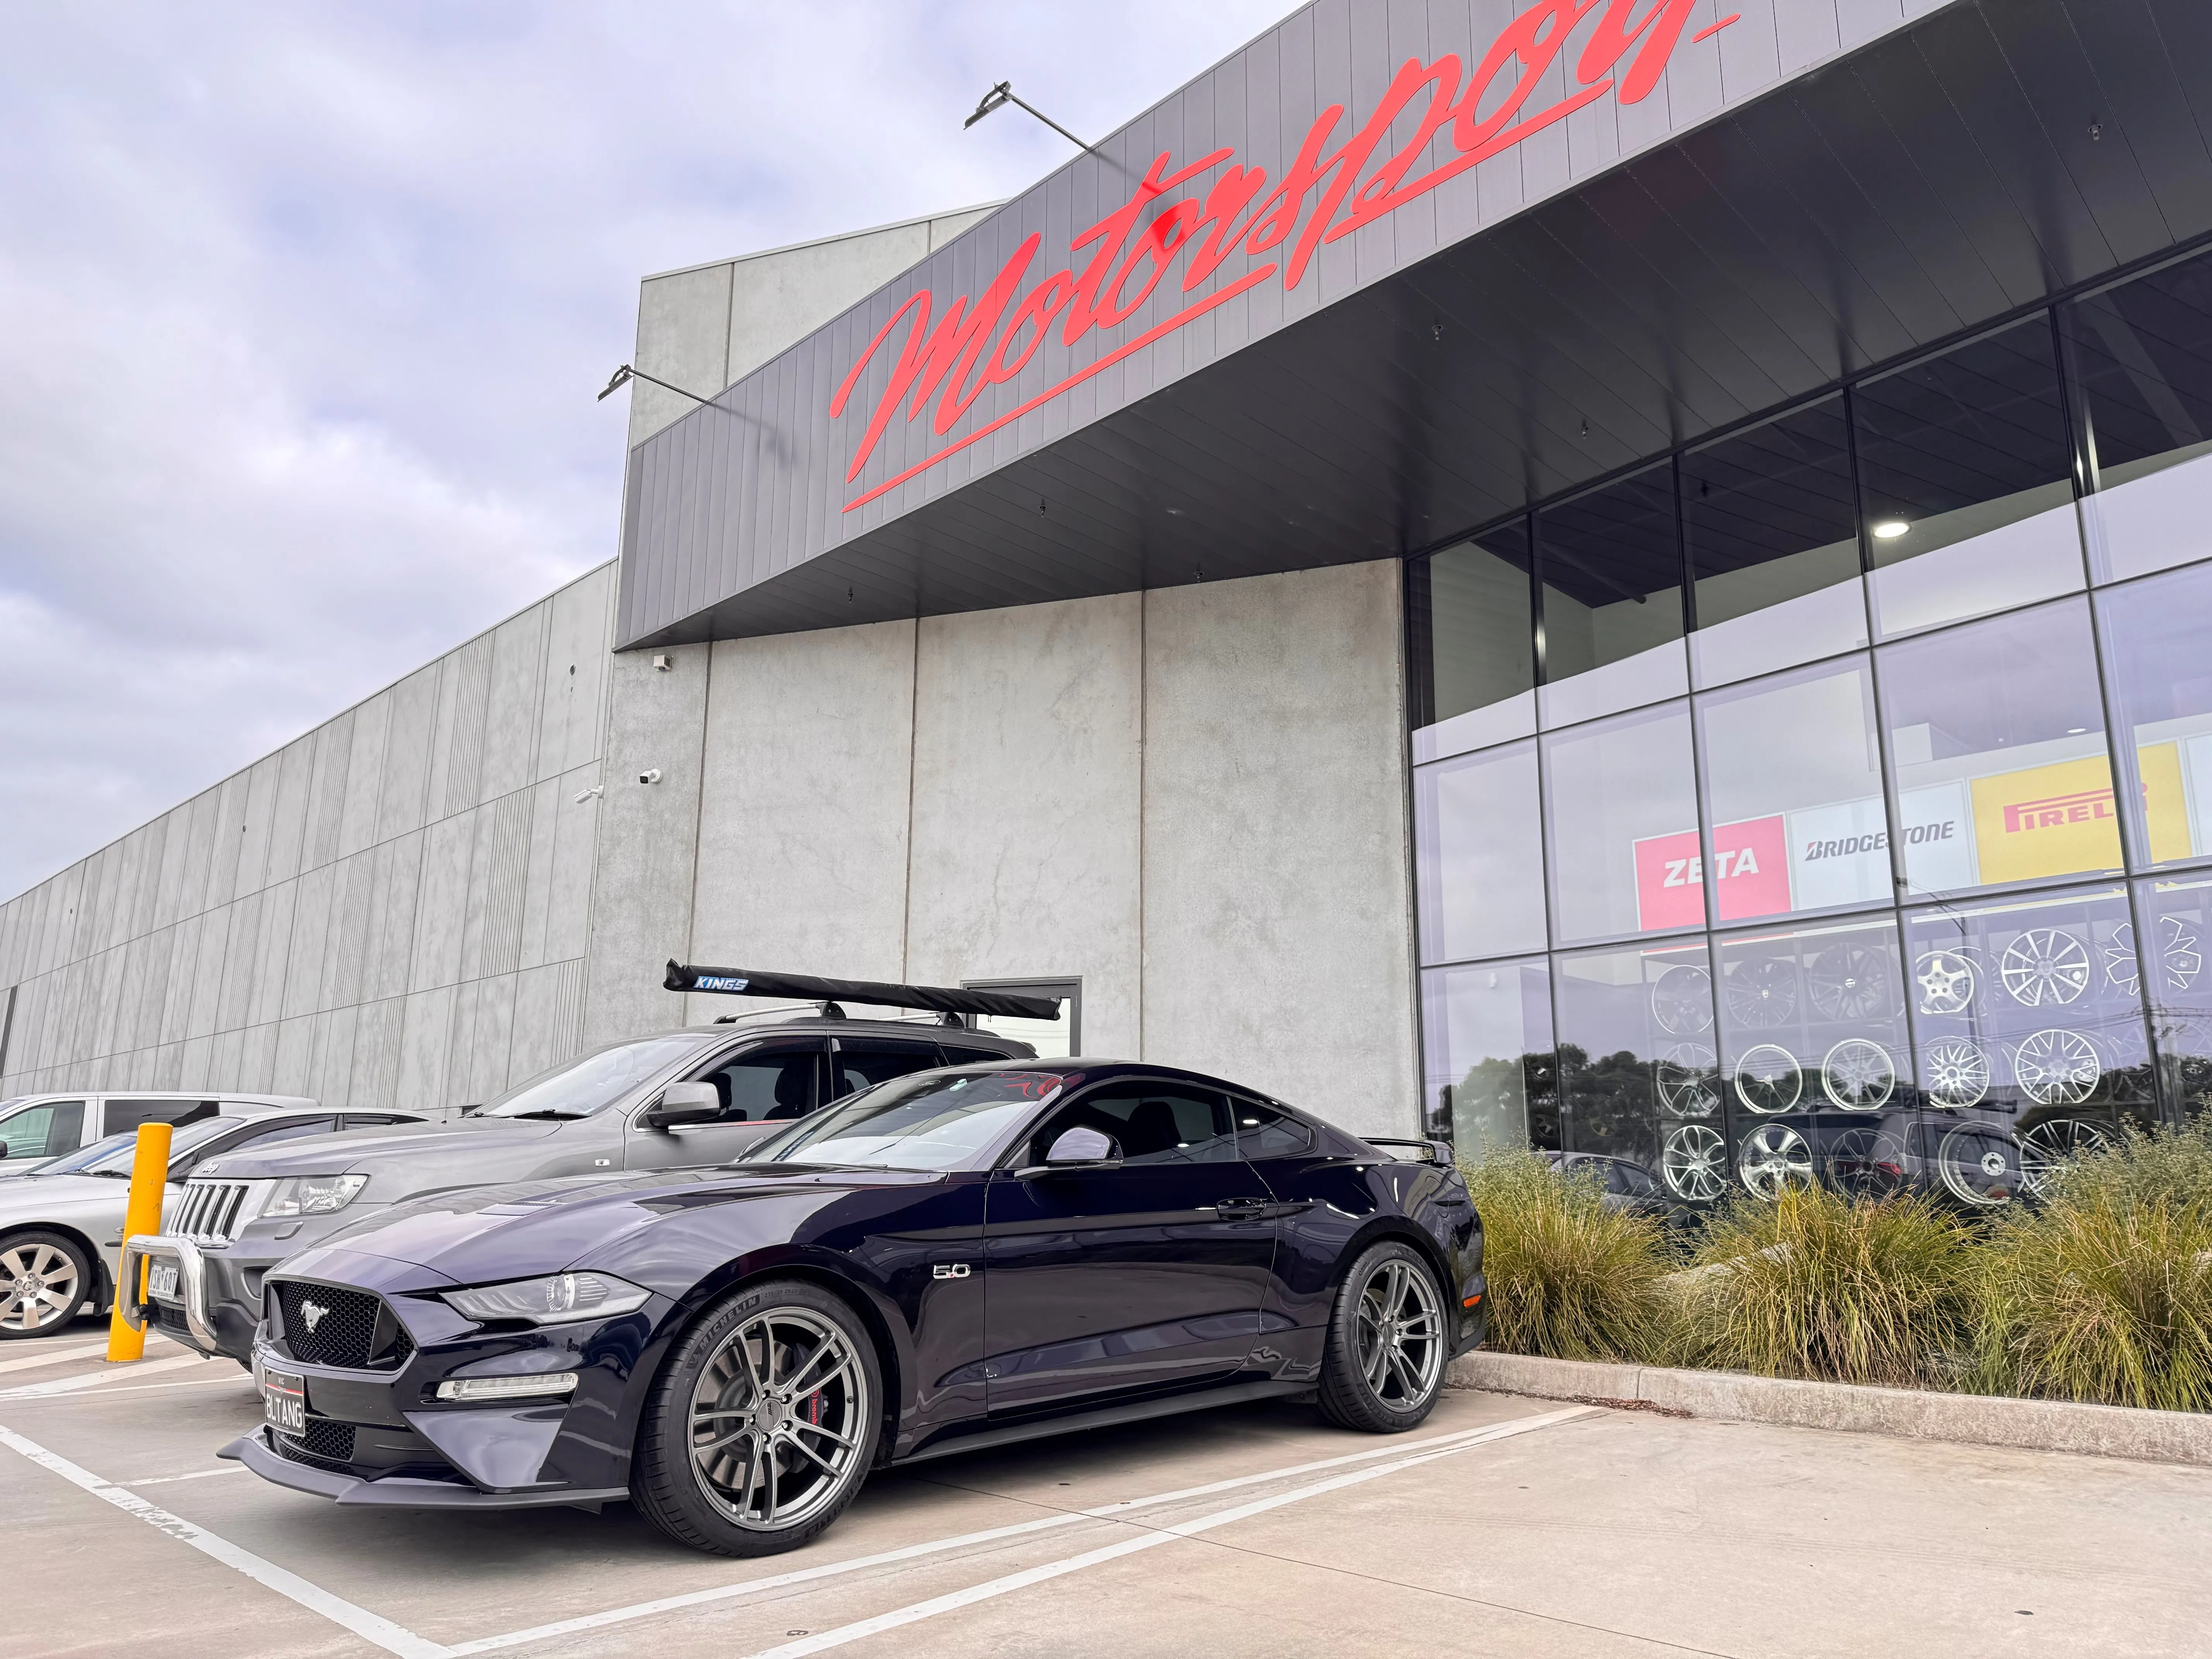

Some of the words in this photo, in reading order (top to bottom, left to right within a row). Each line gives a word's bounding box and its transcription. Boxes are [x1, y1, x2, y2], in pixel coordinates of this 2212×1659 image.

[2003, 782, 2148, 833] PIREL
[1805, 821, 1954, 861] BRIDGETONE
[1664, 847, 1759, 888] ZETA
[694, 977, 749, 991] KINGS
[933, 1264, 970, 1279] 5.0
[699, 1297, 757, 1351] MICHELIN
[266, 1393, 303, 1429] BLTANG
